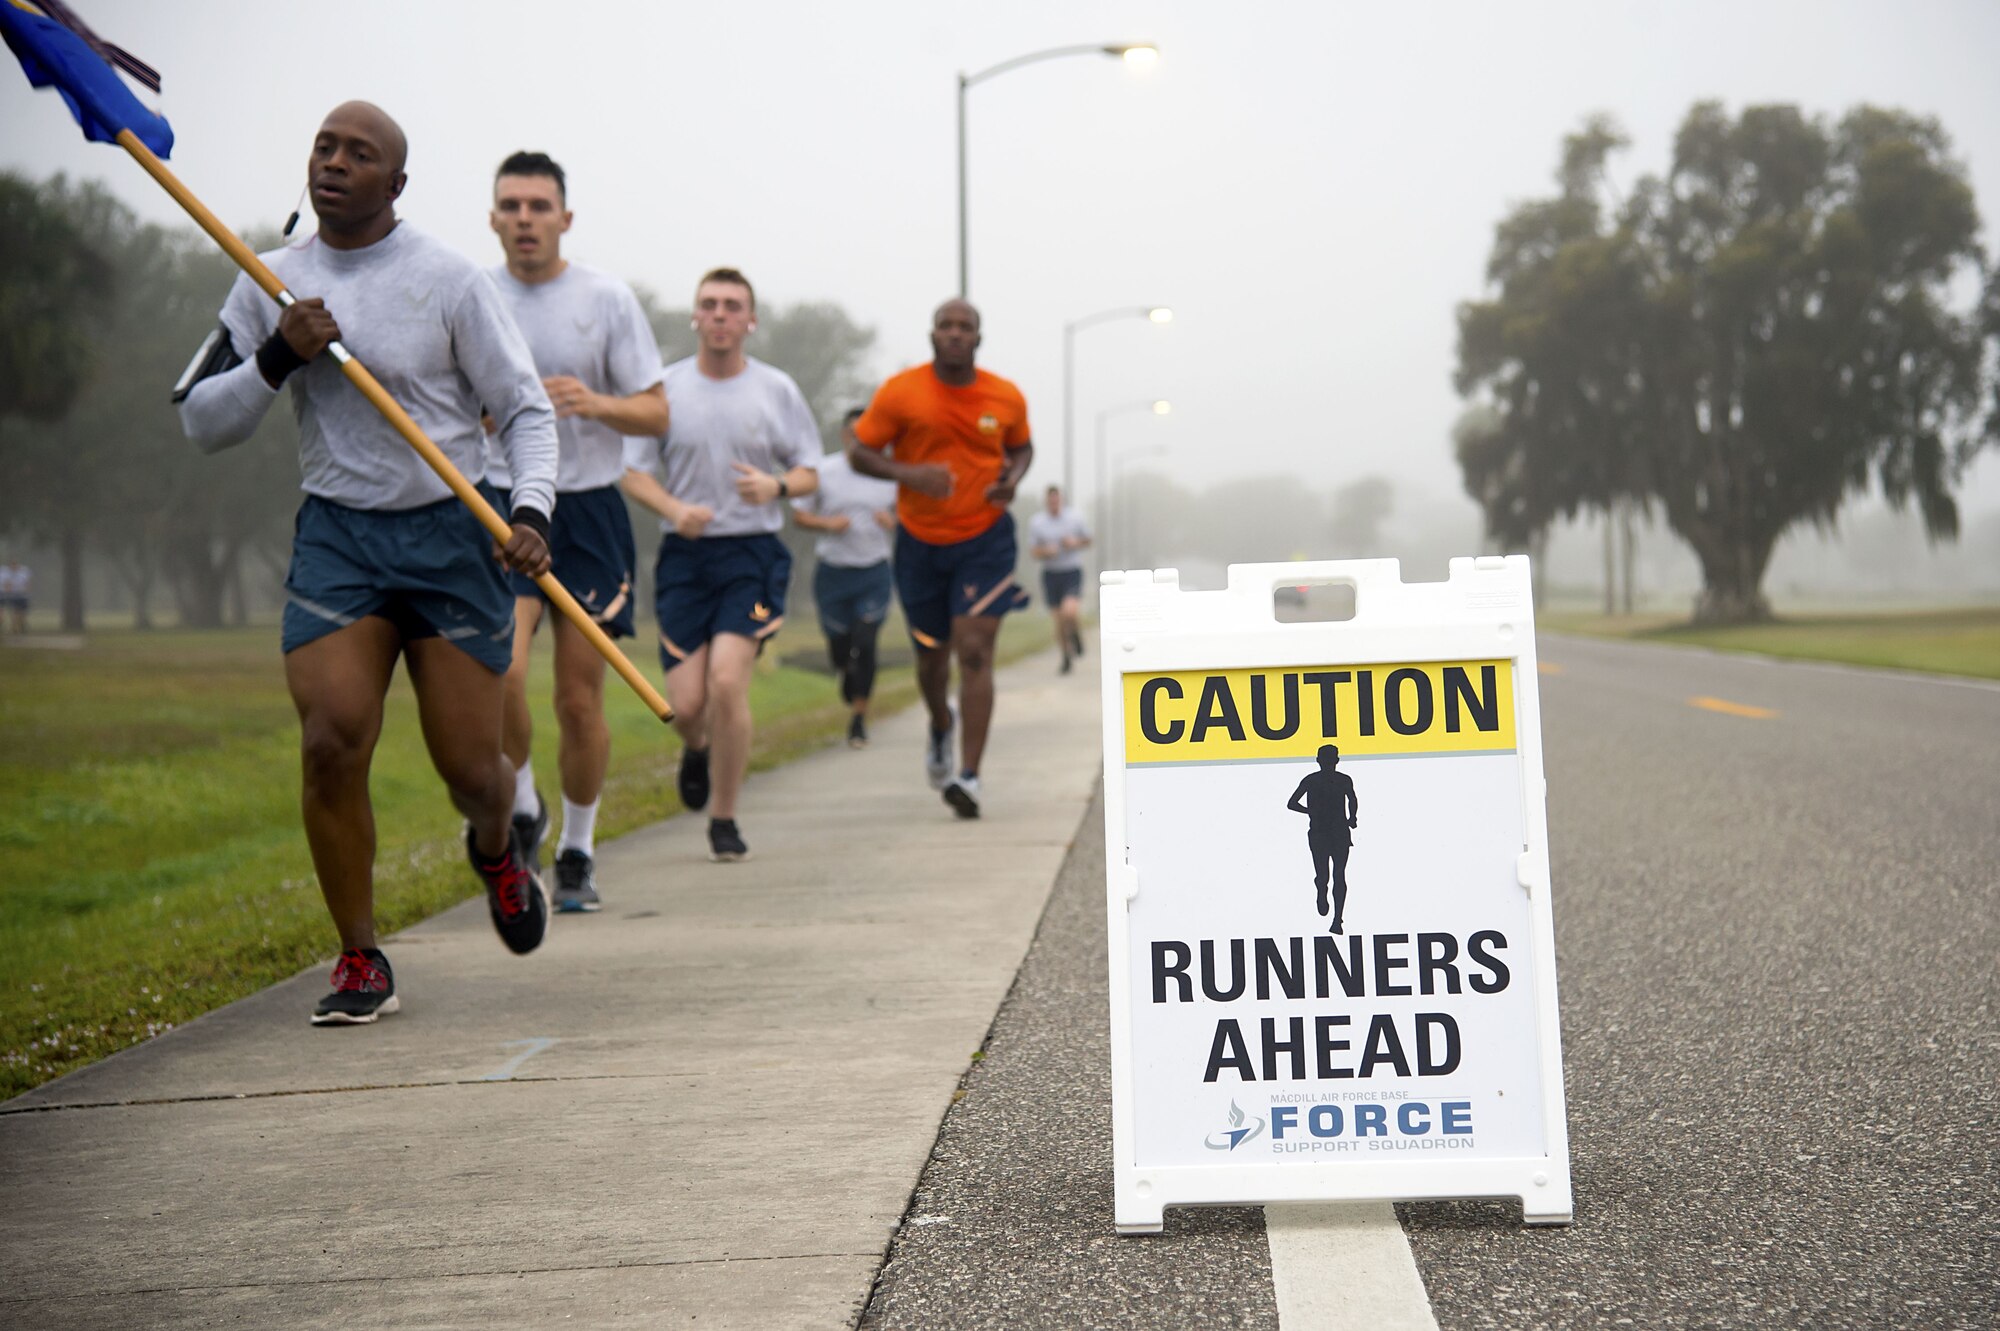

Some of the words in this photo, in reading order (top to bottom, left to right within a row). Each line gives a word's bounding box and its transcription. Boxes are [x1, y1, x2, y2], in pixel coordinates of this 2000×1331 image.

[1139, 665, 1499, 744] CAUTION
[1151, 930, 1511, 1003] RUNNERS
[1203, 1012, 1462, 1083] AHEAD
[1270, 1093, 1317, 1103] MACDILL
[1320, 1092, 1339, 1102] AIR
[1342, 1091, 1378, 1101] FORCE
[1381, 1090, 1409, 1100] BASE
[1271, 1101, 1473, 1139] FORCE
[1272, 1140, 1360, 1153] SUPPORT
[1368, 1137, 1474, 1151] SQUADRON
